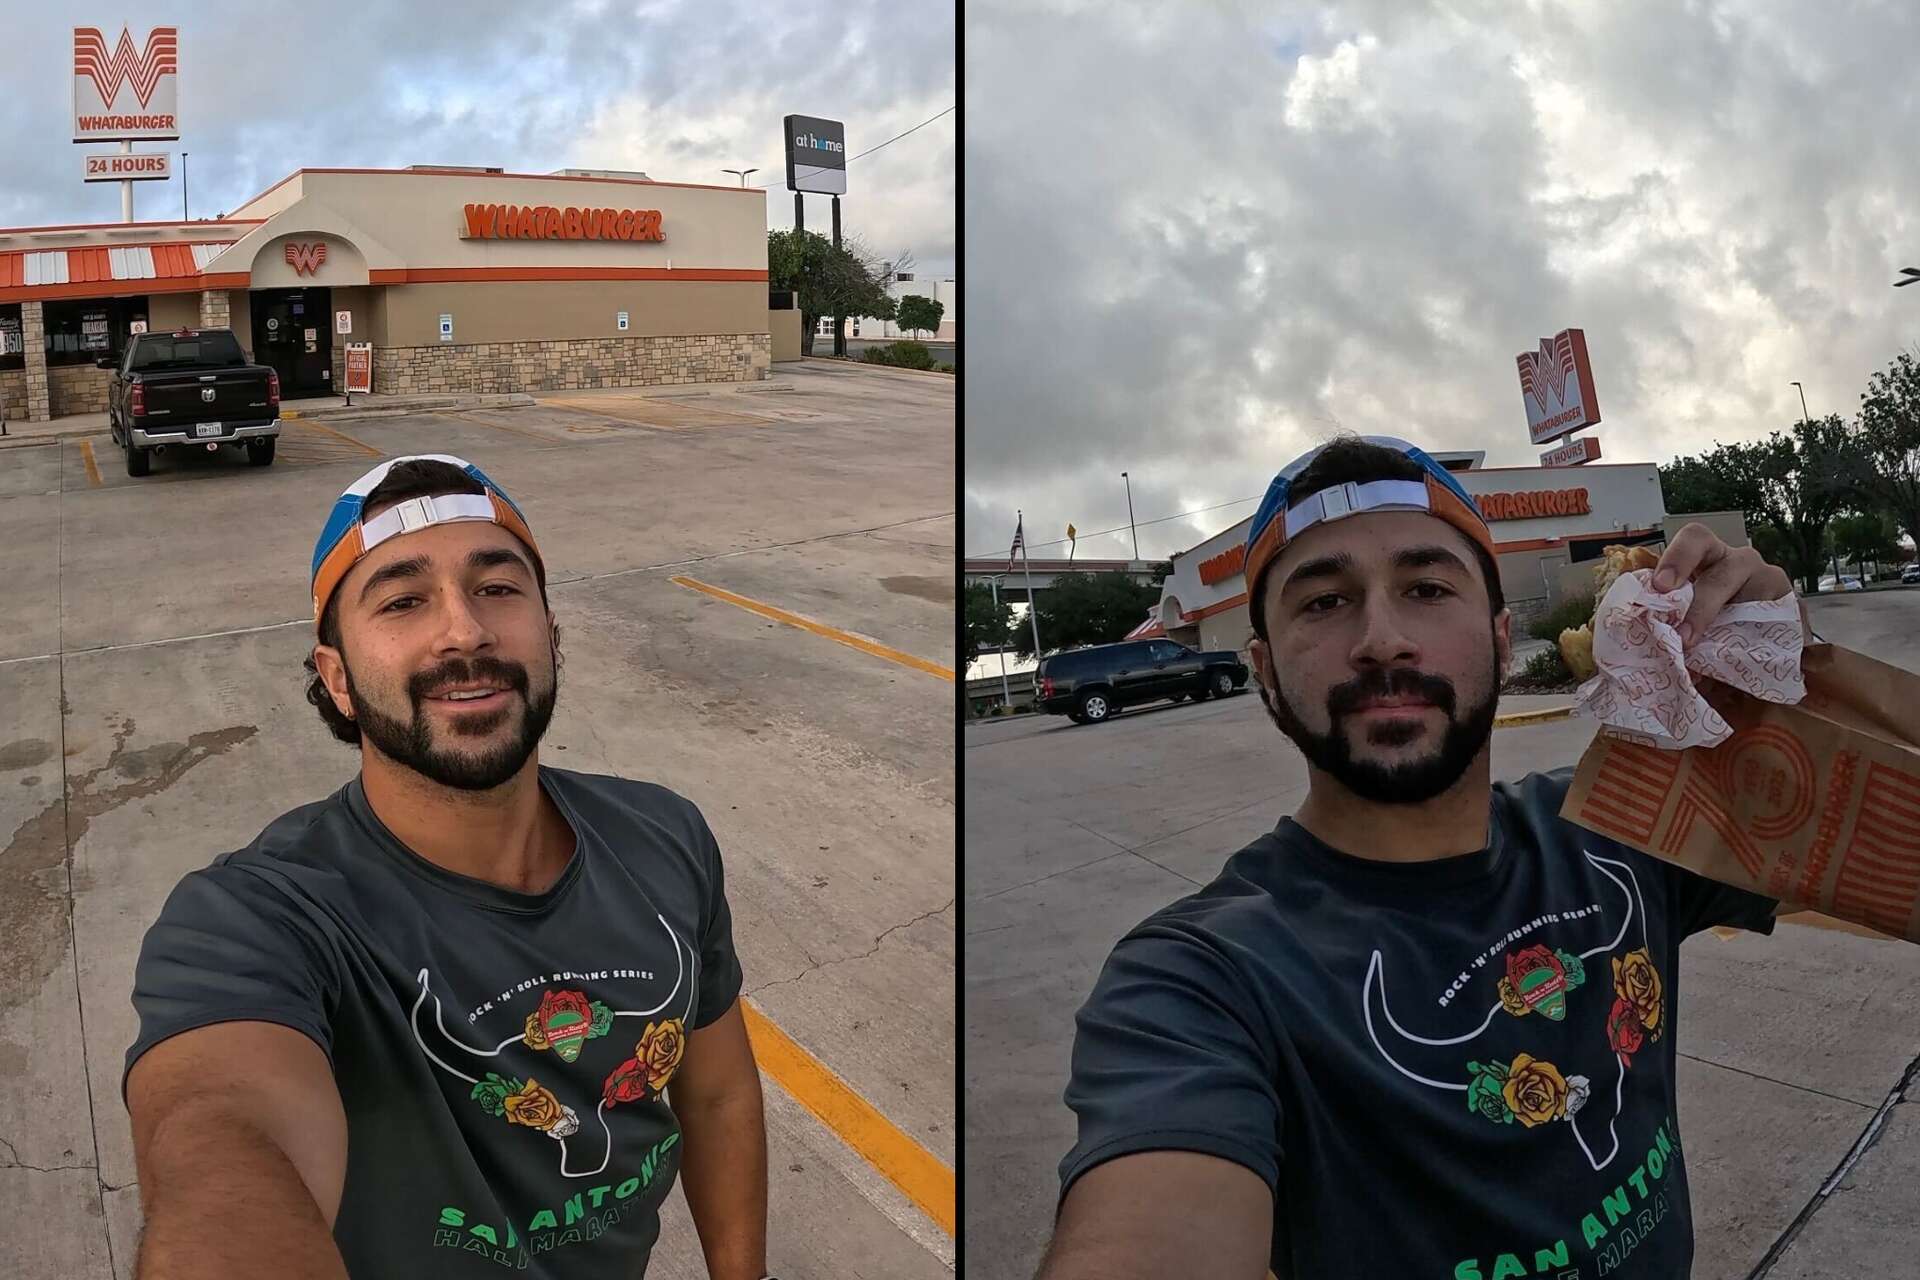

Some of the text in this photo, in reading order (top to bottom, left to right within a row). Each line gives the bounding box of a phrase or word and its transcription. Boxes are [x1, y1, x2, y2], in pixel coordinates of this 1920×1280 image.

[78, 114, 174, 131] WHATABURGER
[795, 134, 808, 148] at
[89, 157, 165, 174] 24 HOURS
[464, 204, 662, 241] WHATABURGER
[1531, 406, 1582, 437] WHATABURGER
[1553, 443, 1583, 465] HOURS
[517, 975, 547, 993] ROLL
[552, 970, 608, 982] RUING
[613, 970, 654, 980] SERIES
[1438, 971, 1471, 1007] ROCK
[528, 1132, 681, 1231] ANTONIO
[1454, 1117, 1672, 1280] SAN ANTON
[1597, 1187, 1671, 1277] MARA
[433, 1229, 528, 1270] HAL
